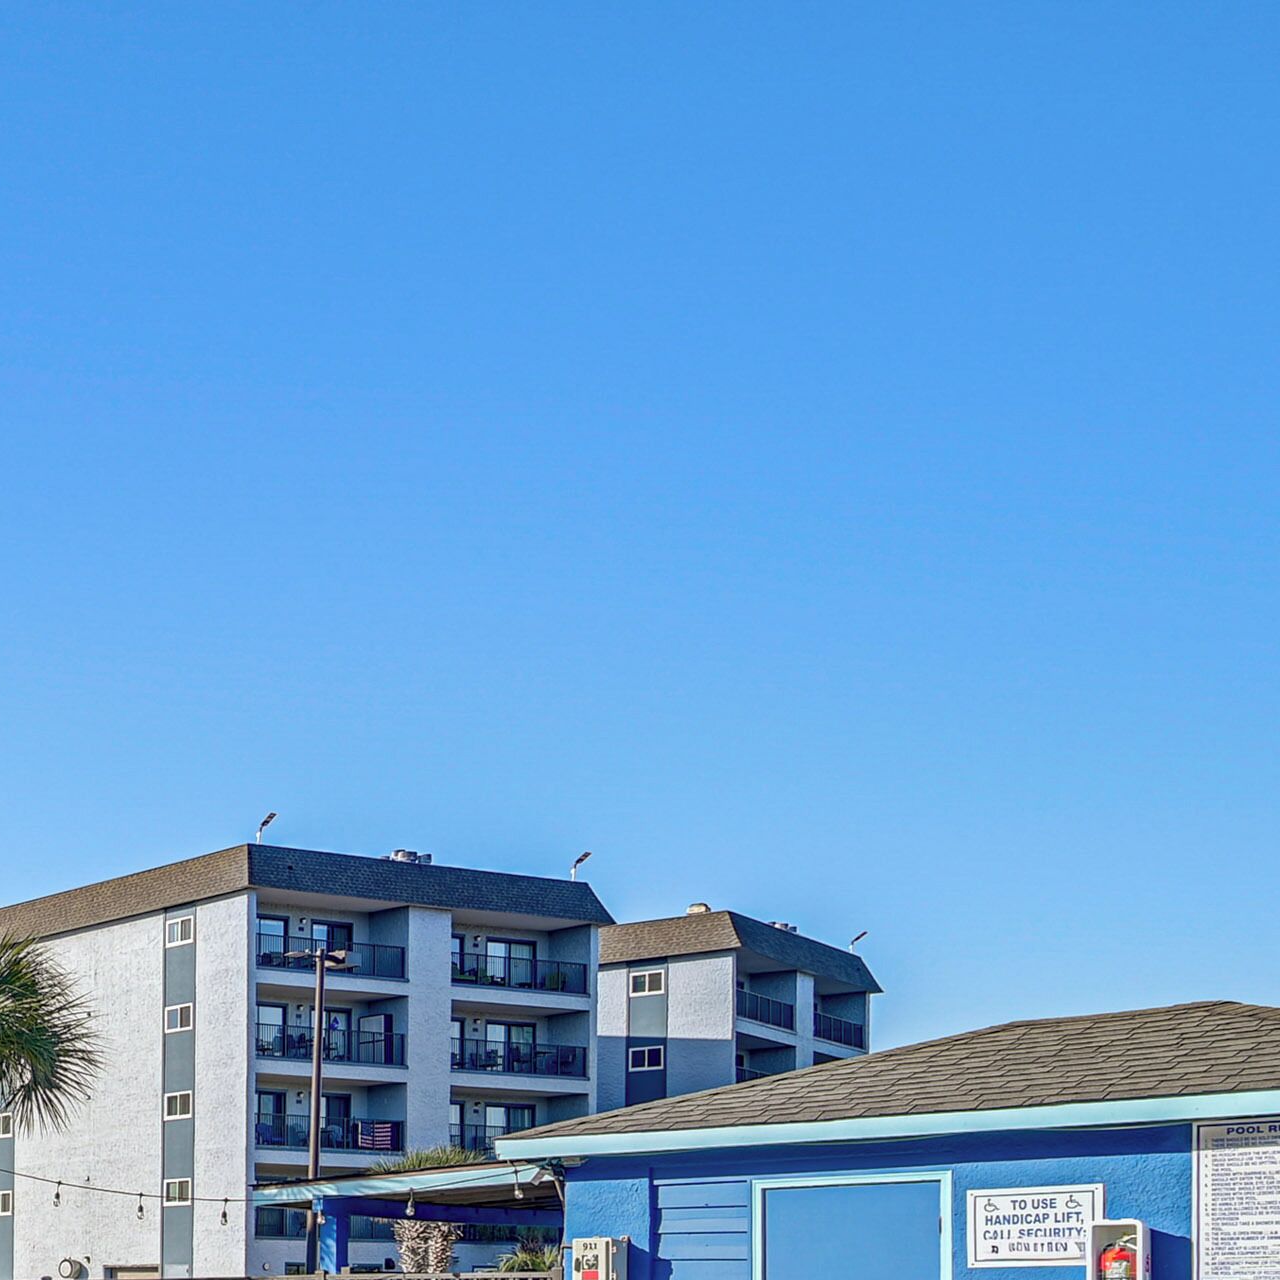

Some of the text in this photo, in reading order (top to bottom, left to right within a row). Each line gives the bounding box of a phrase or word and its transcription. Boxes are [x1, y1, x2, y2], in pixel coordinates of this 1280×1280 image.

[1227, 1126, 1264, 1135] POOL
[1011, 1198, 1057, 1210] TO USE
[985, 1212, 1084, 1226] HANDICAP LIFT,
